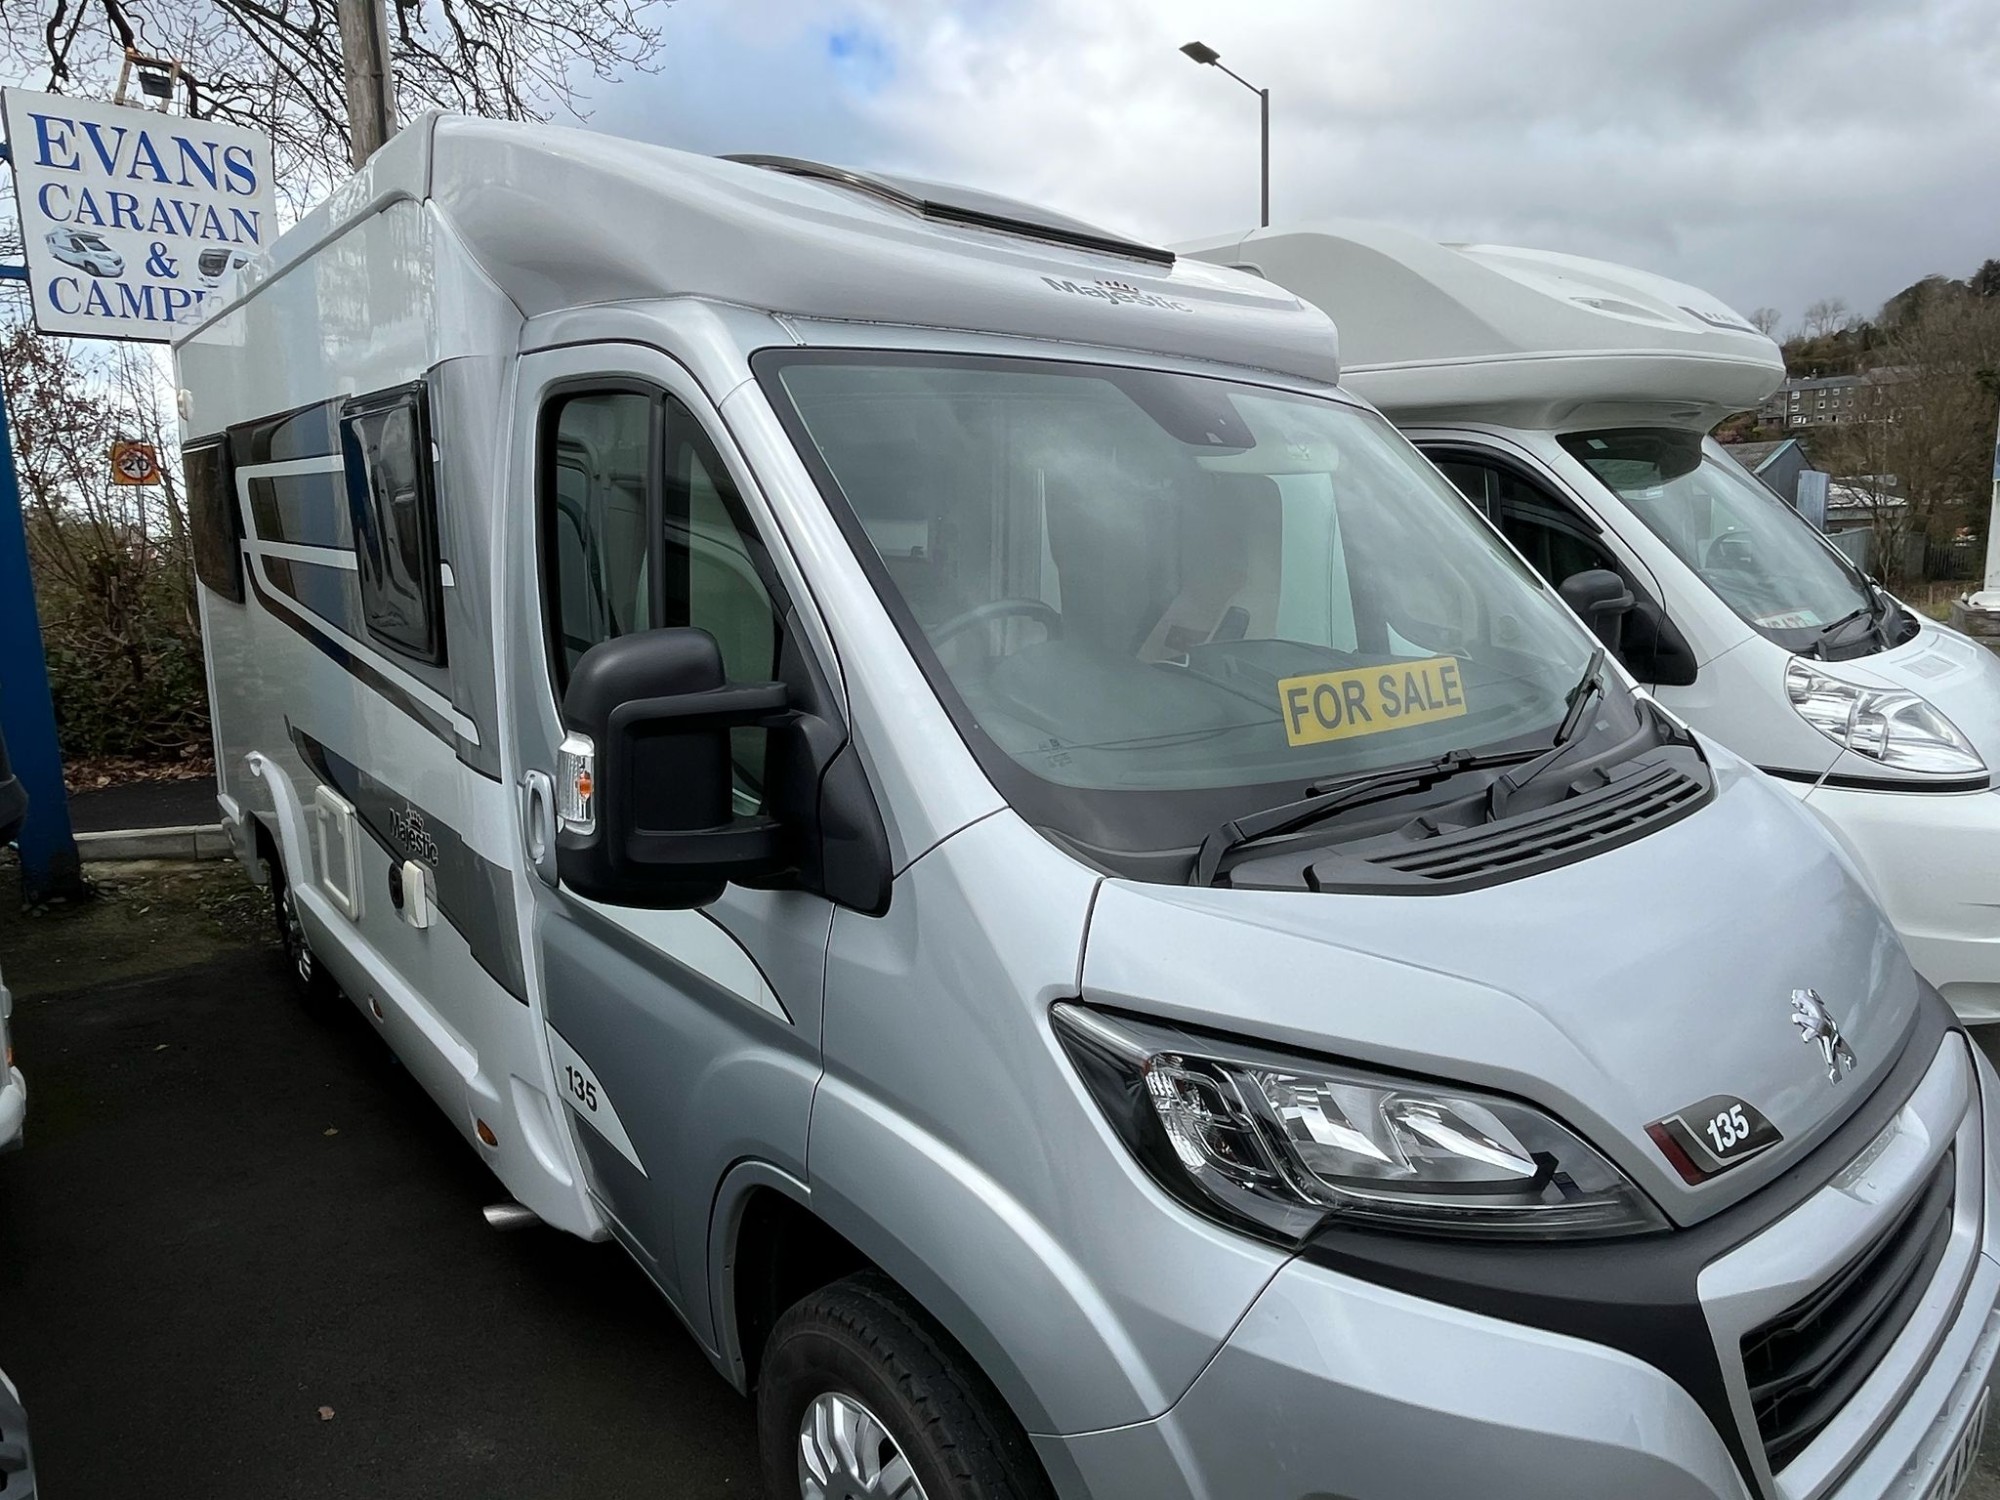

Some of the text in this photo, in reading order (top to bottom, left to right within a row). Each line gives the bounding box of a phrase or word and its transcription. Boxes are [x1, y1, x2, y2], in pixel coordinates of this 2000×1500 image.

[27, 112, 258, 196] EVANS
[38, 182, 260, 245] CARAVAN
[145, 241, 180, 279] &
[1040, 276, 1193, 313] Majestic
[1287, 665, 1462, 735] FOR SALE
[389, 807, 439, 867] Majestic
[565, 1065, 598, 1112] 135
[1706, 1103, 1750, 1153] 135
